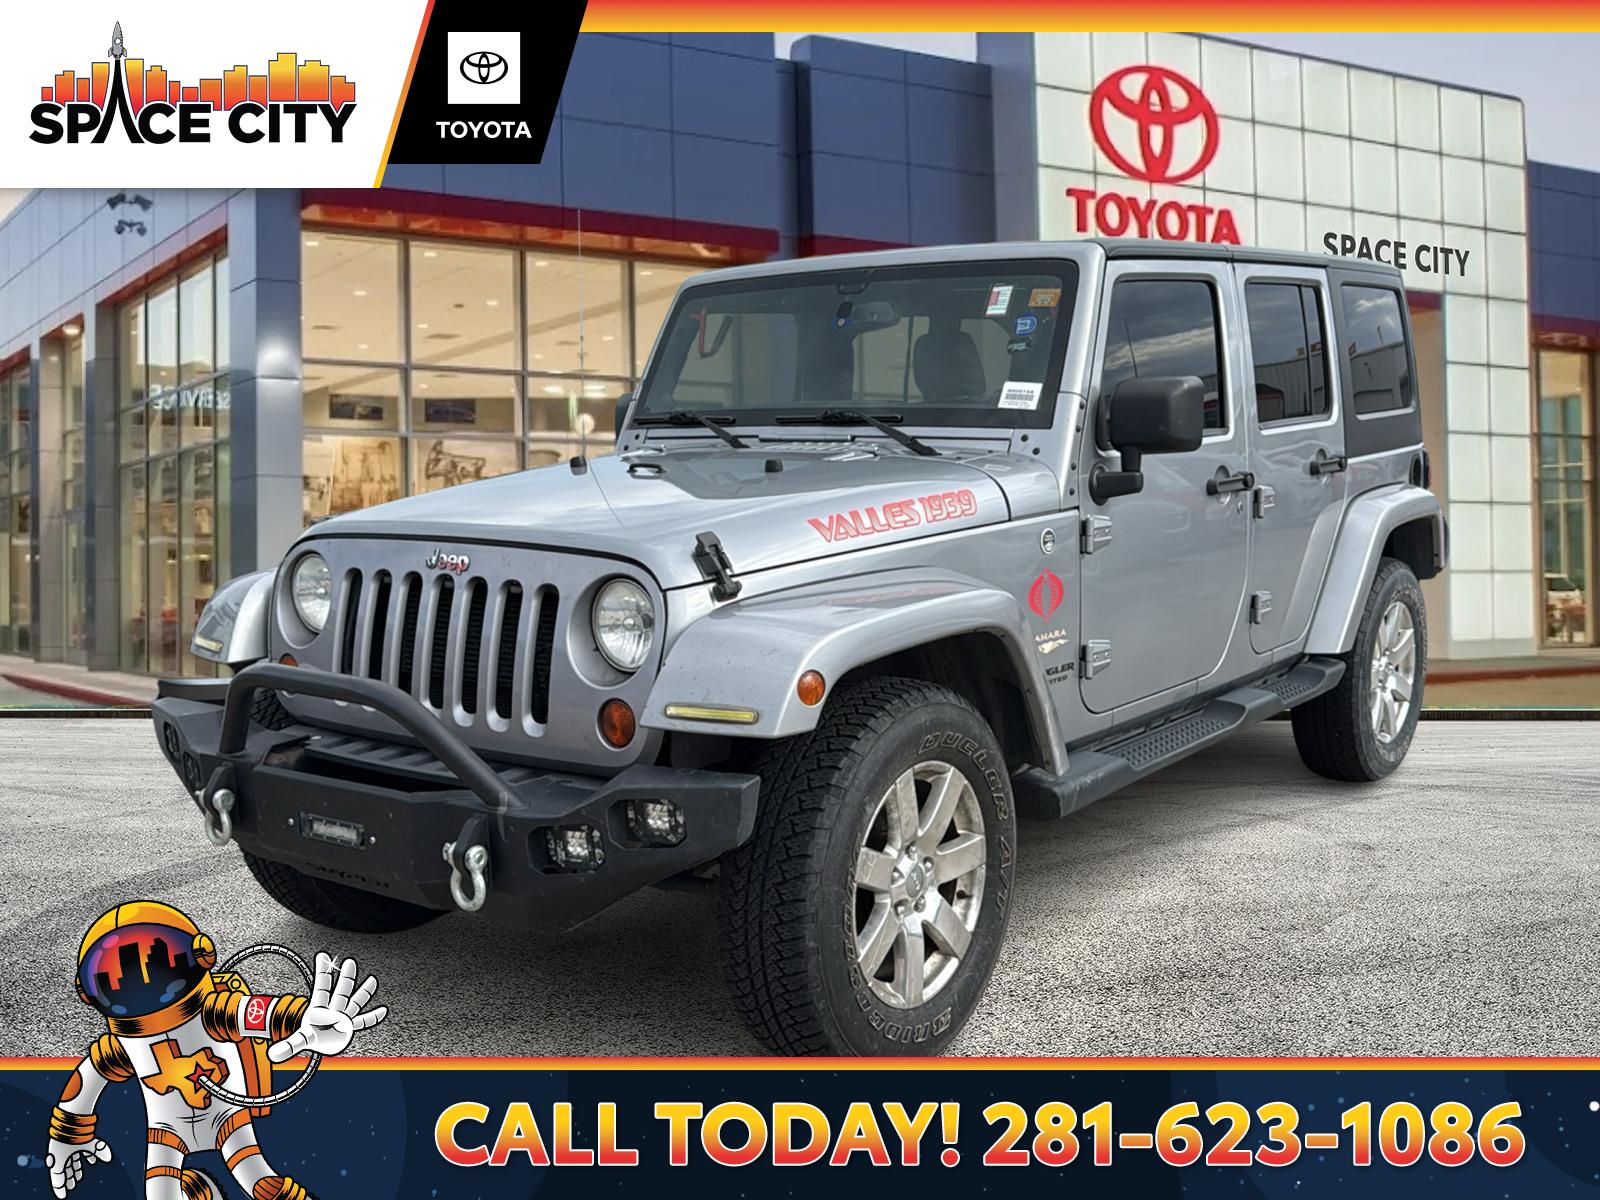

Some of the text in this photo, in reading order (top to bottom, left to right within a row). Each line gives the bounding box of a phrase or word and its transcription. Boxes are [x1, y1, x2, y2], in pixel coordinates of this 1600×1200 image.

[1066, 188, 1241, 246] TOYOTA
[1324, 232, 1470, 276] SPACE CITY
[807, 488, 978, 544] VALLES 1939
[425, 547, 471, 576] Jeep
[1035, 628, 1067, 642] AHARA
[918, 731, 1009, 821] DUELER
